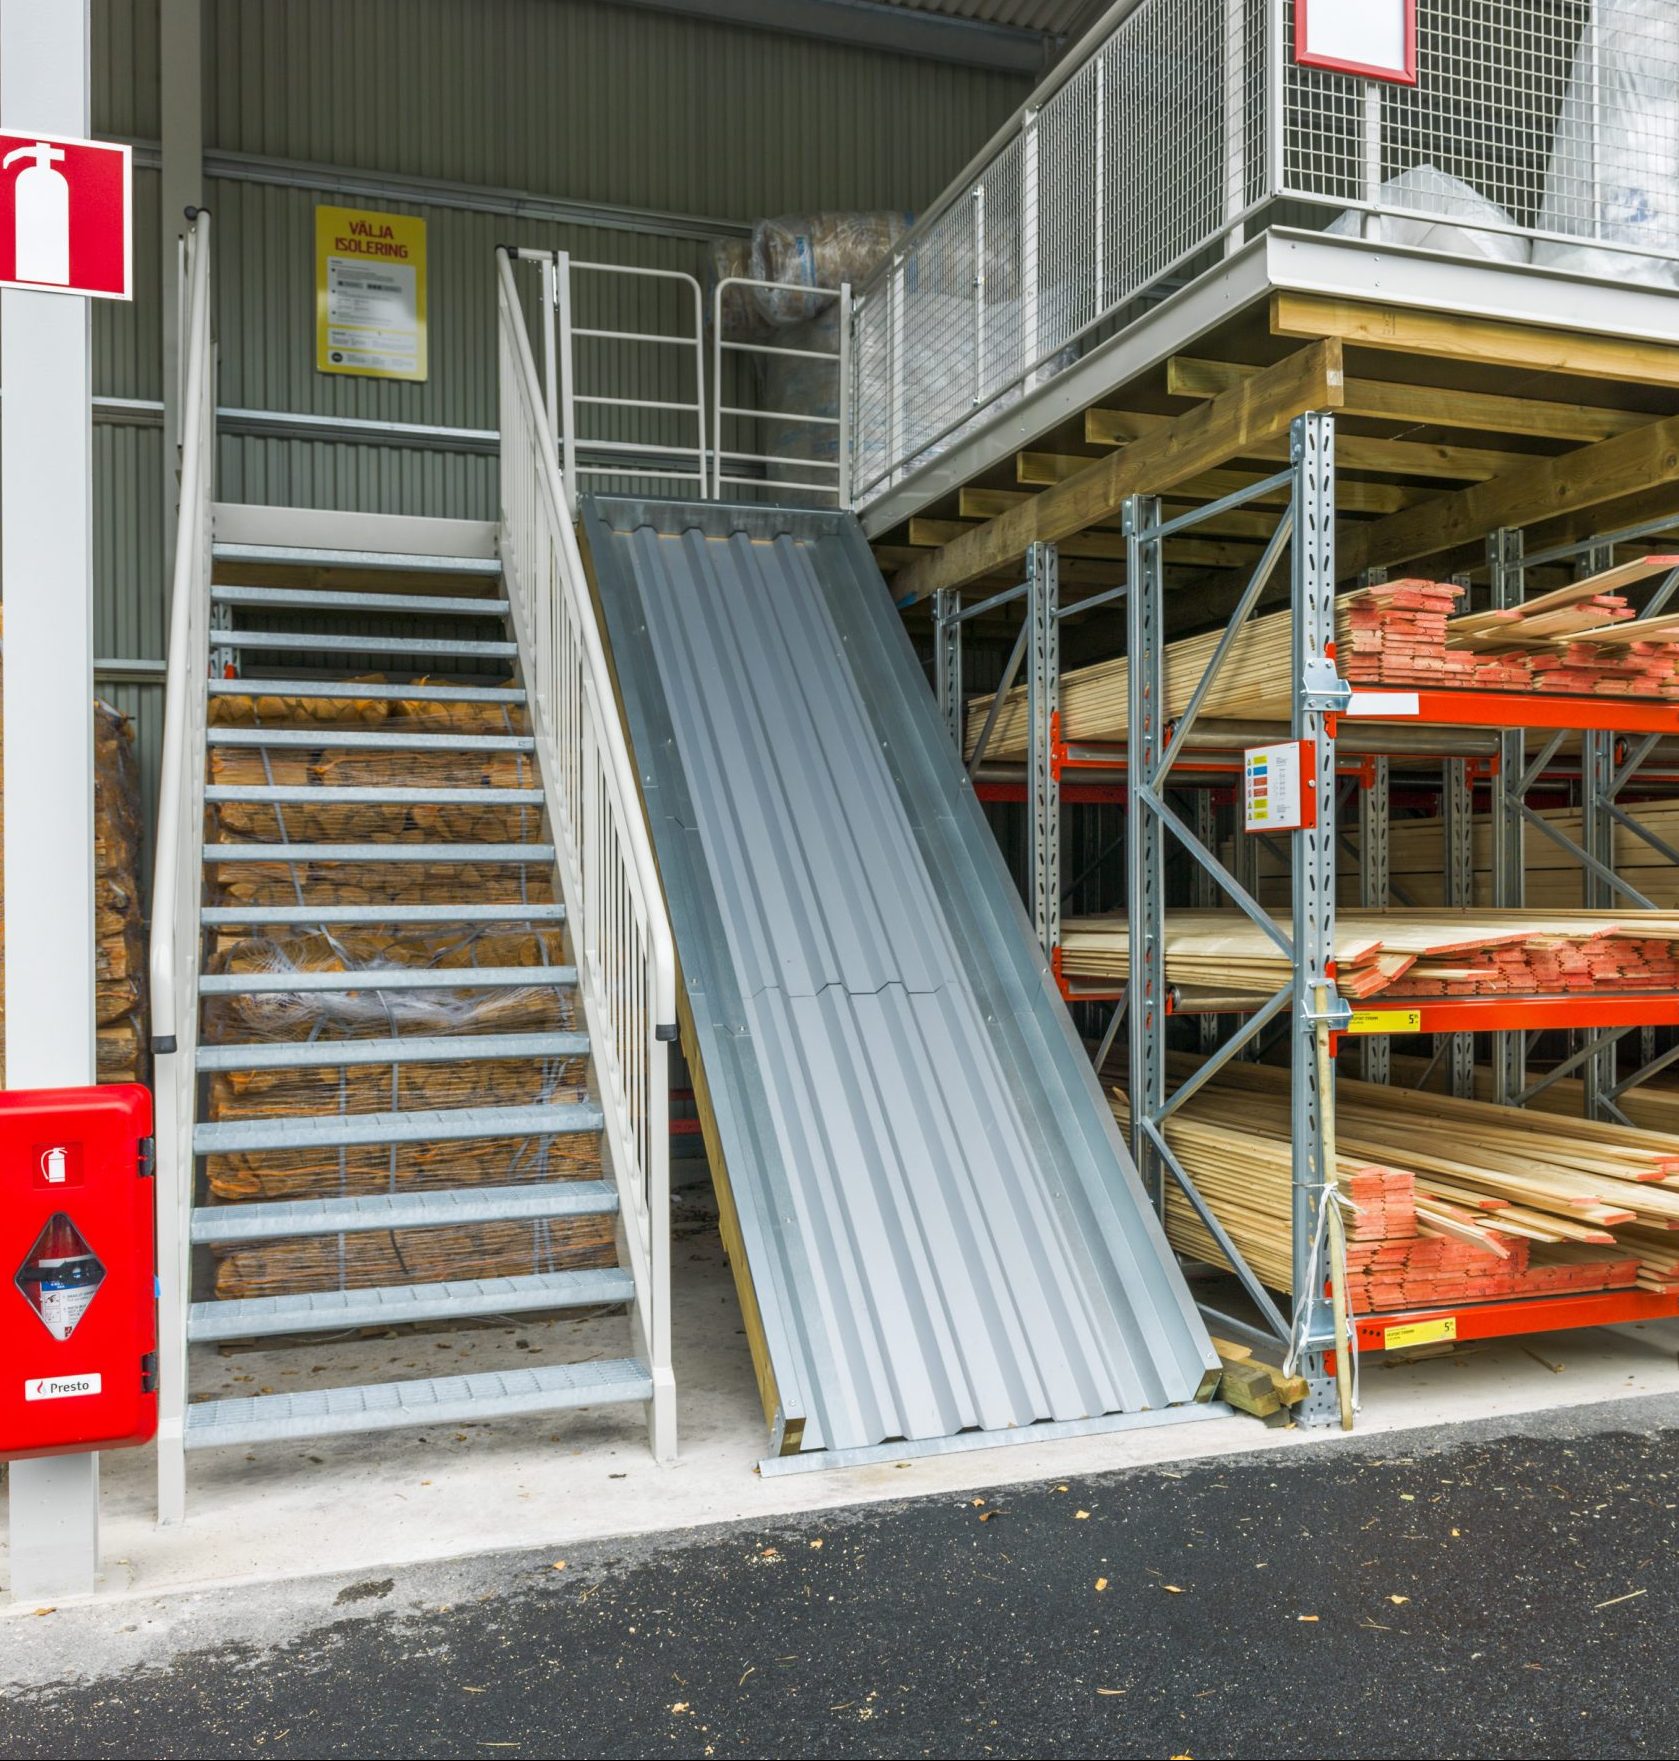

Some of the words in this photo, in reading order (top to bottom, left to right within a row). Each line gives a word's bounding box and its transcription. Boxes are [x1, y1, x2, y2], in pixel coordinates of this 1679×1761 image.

[349, 220, 394, 240] VÄLJA
[335, 238, 408, 258] ISOLERING
[50, 1381, 90, 1394] Presto
